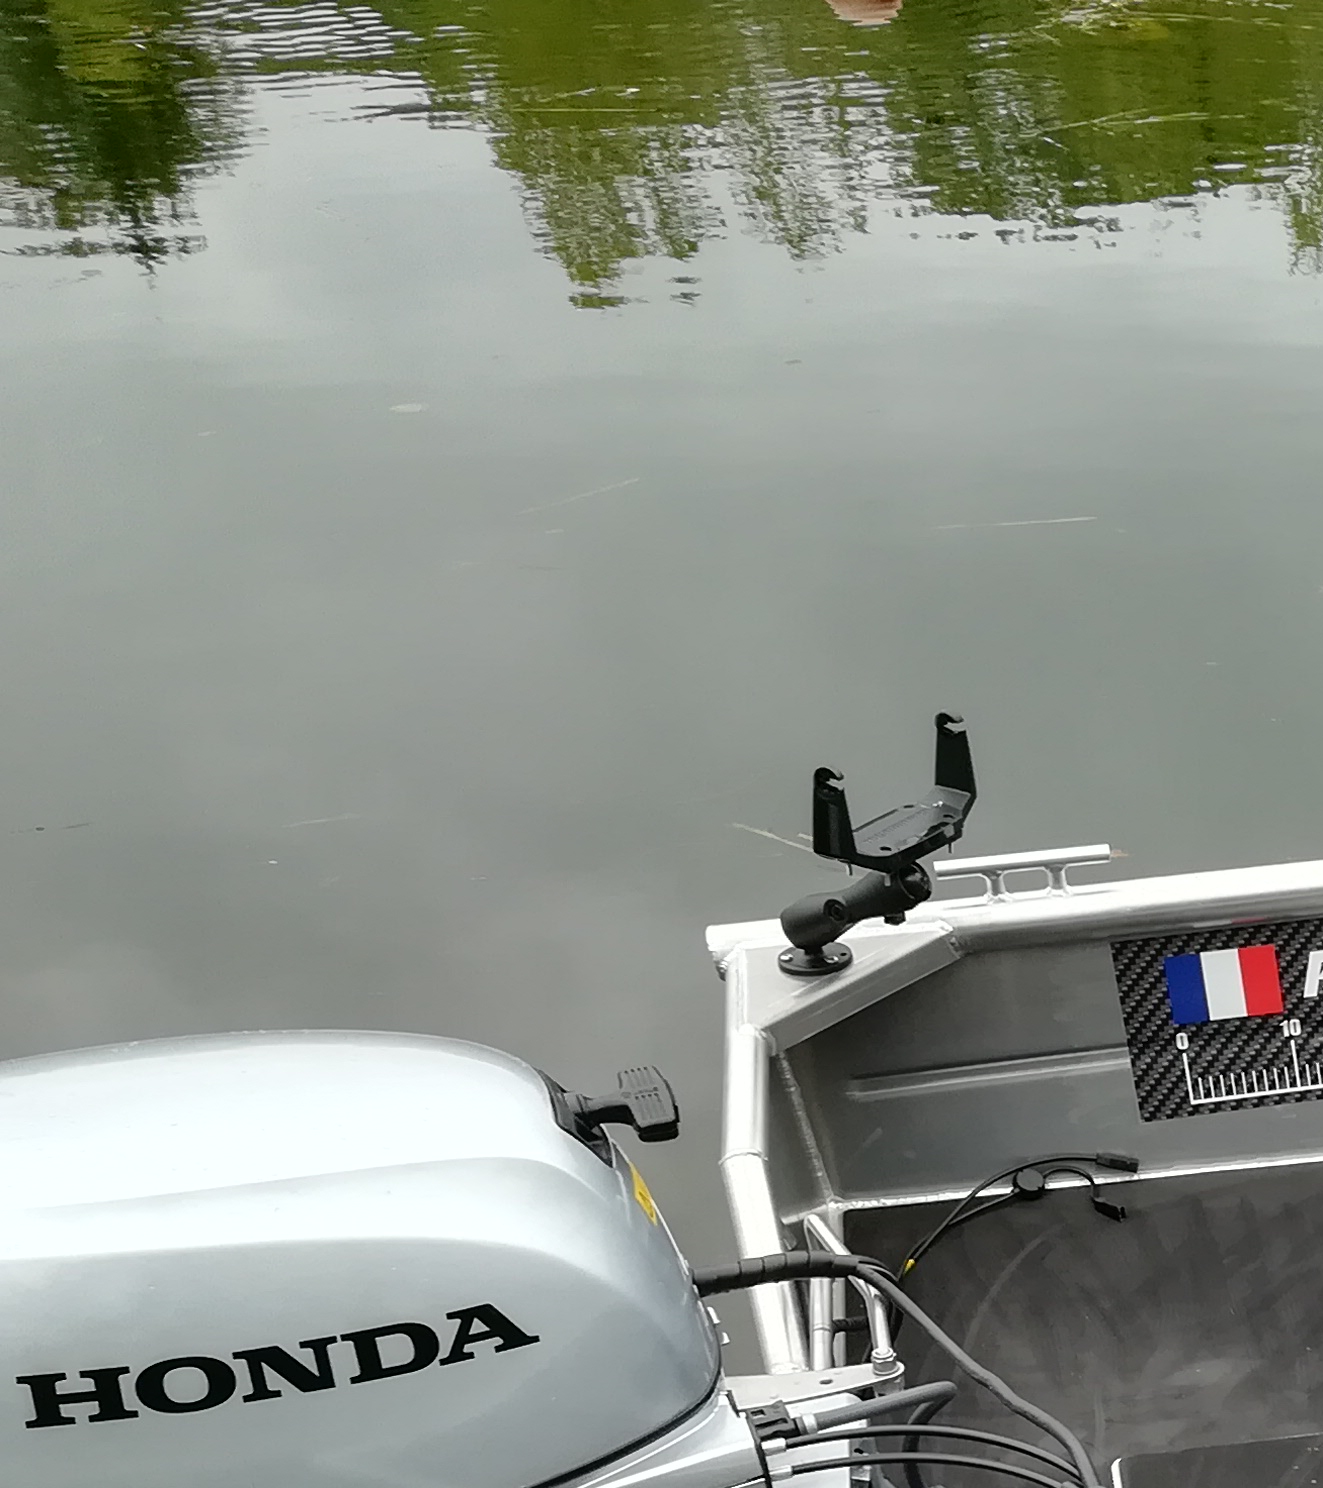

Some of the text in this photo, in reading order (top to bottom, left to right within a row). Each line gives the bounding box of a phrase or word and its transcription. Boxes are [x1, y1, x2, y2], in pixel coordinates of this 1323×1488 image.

[1176, 1033, 1188, 1049] 0
[1280, 1019, 1301, 1037] 10
[16, 1304, 539, 1428] HONDA
